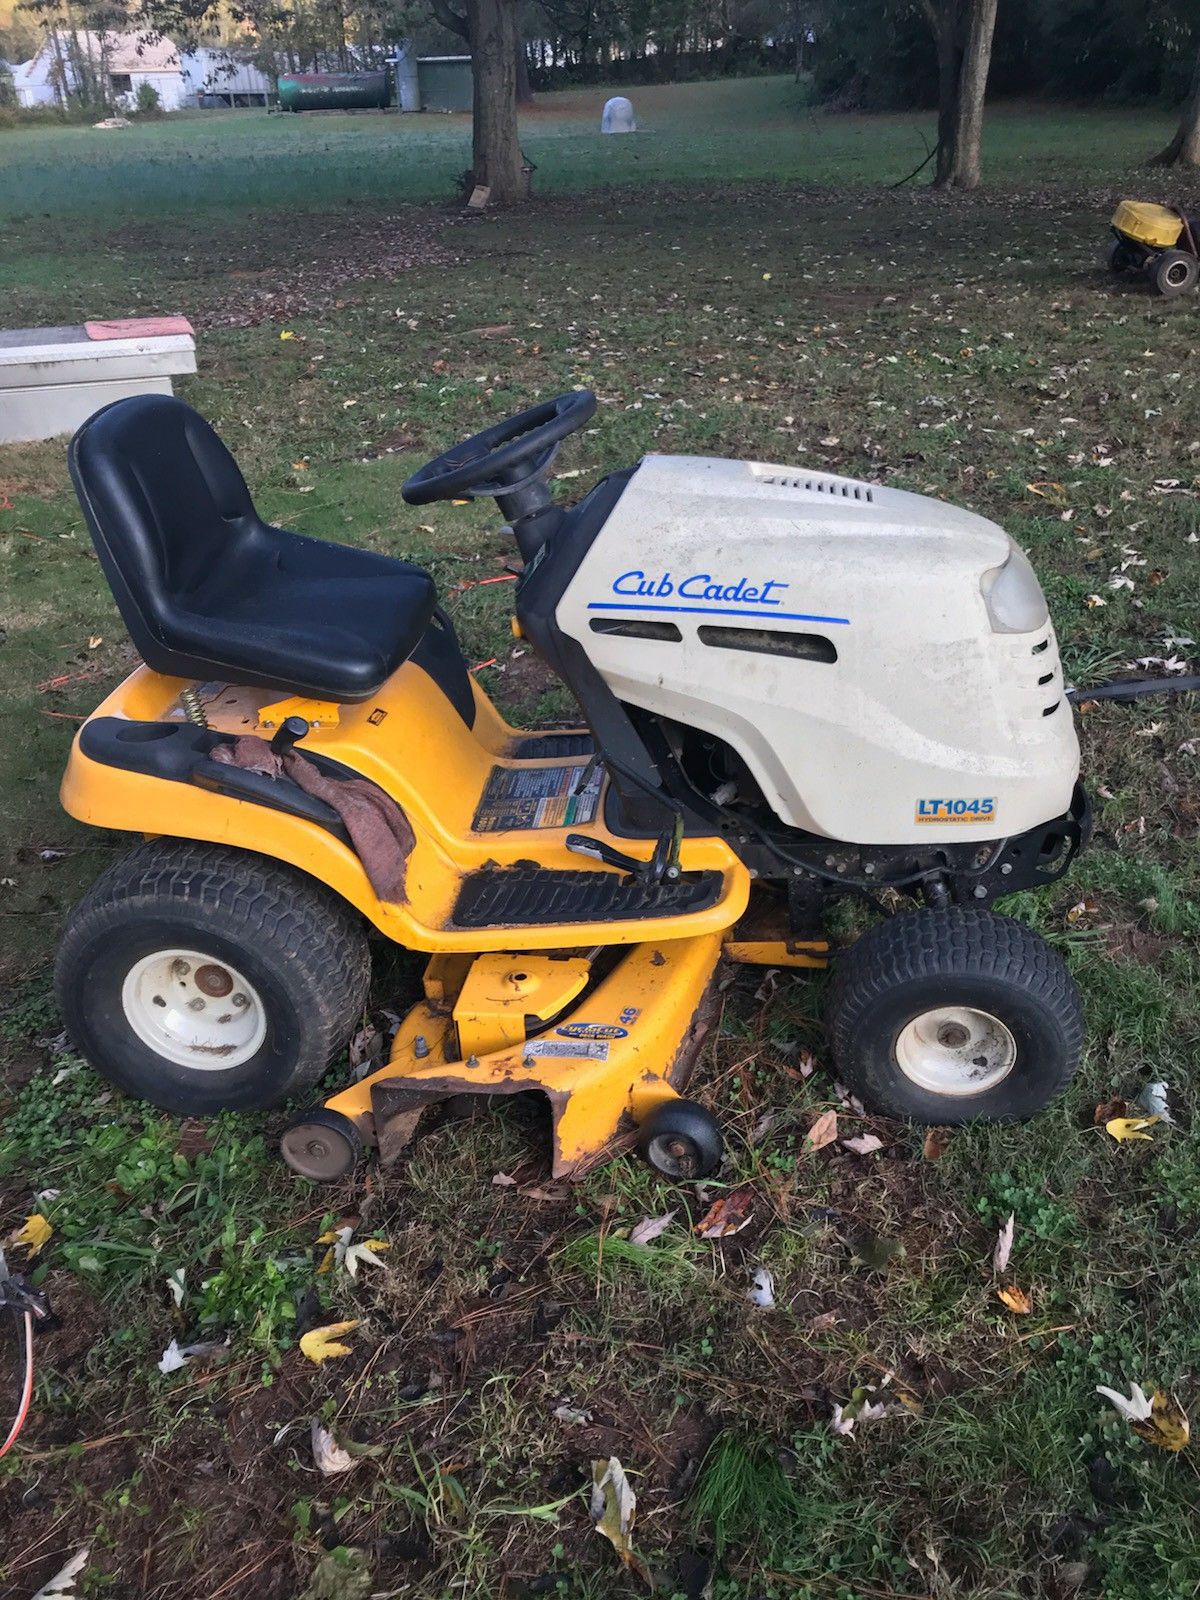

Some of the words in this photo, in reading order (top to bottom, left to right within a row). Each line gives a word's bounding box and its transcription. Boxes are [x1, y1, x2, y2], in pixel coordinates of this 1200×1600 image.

[612, 571, 674, 597] Cub
[678, 574, 790, 605] Cadet
[919, 799, 993, 814] LT1045
[620, 1007, 636, 1024] 46
